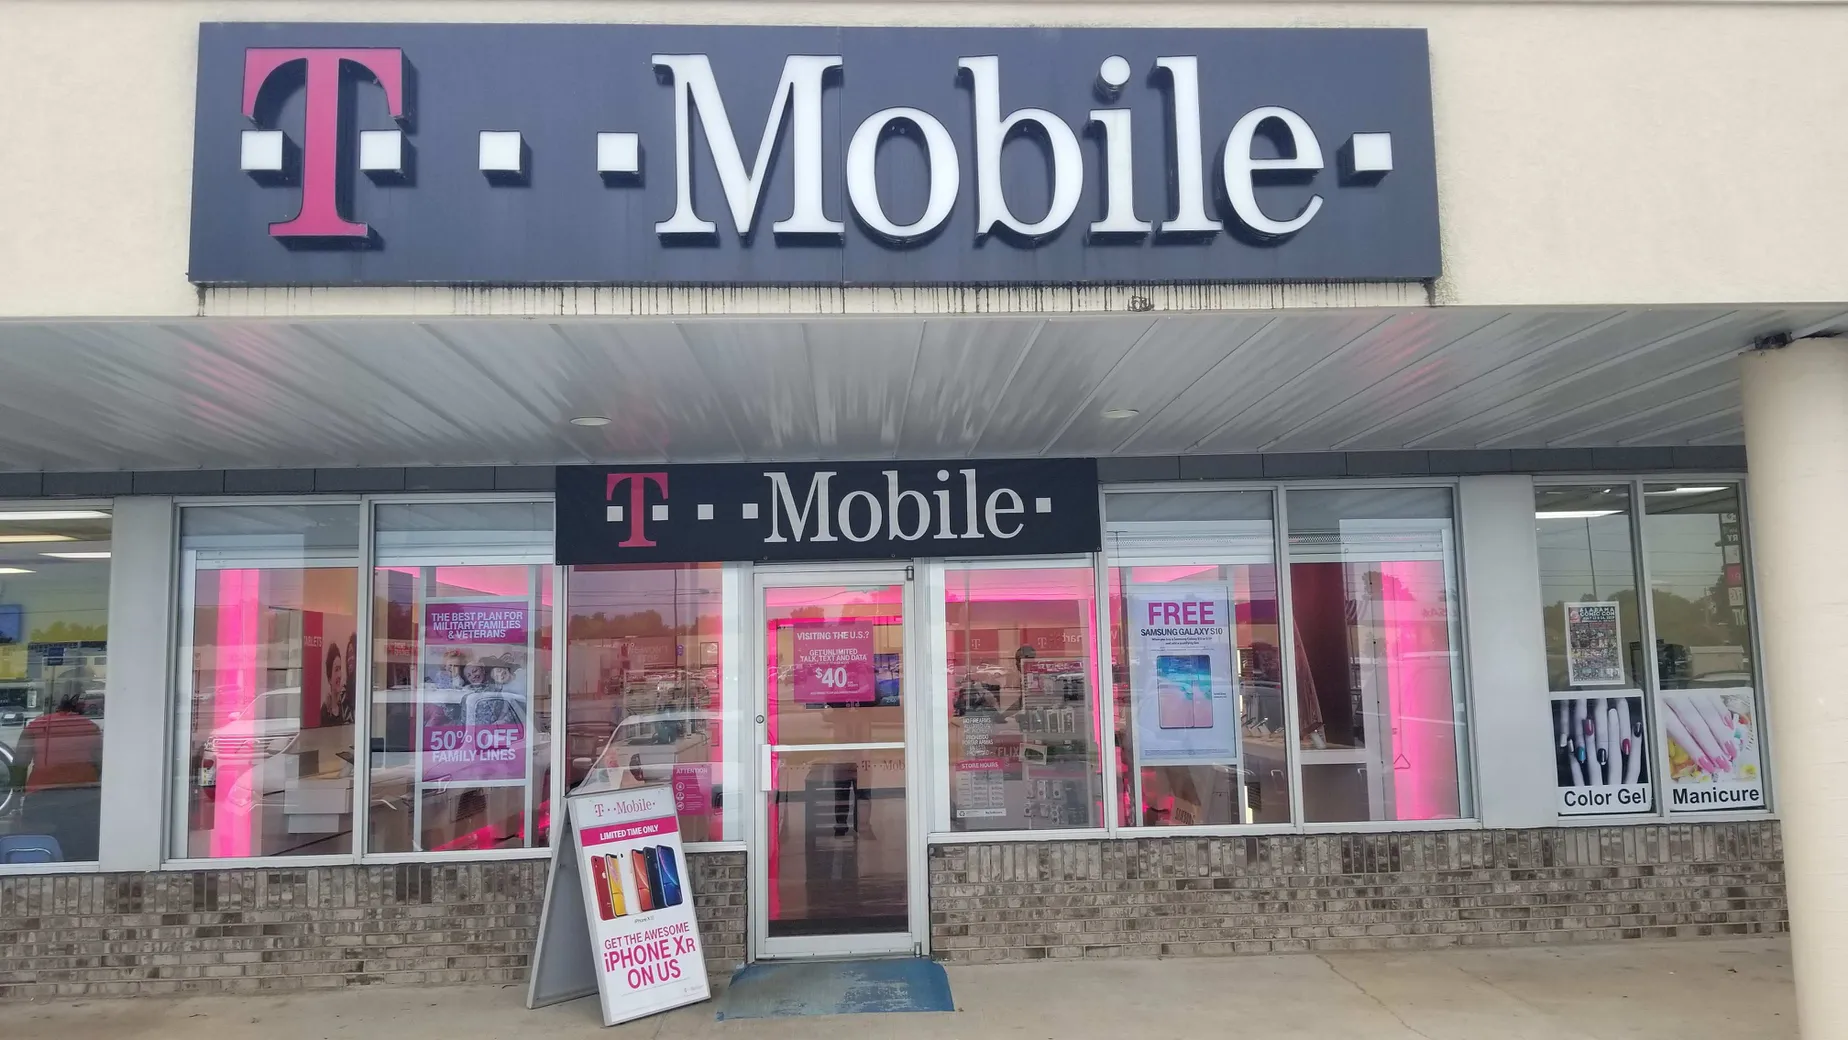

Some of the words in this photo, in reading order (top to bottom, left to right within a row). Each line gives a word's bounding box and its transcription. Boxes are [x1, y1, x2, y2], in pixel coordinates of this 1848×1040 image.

[651, 54, 1324, 237] Mobile
[763, 469, 1024, 543] Mobile
[431, 612, 450, 622] THE
[452, 612, 476, 621] BEST
[477, 612, 502, 621] PLAN
[504, 611, 523, 620] FOR
[1148, 602, 1215, 625] FREE
[433, 621, 477, 630] MILITARY
[478, 620, 521, 629] FAMILIES
[1140, 628, 1178, 636] SAMSUNG
[448, 630, 455, 639] &
[456, 629, 506, 639] VETERANS
[797, 632, 831, 640] VISITING
[832, 631, 849, 639] THE
[850, 631, 870, 639] U.S.?
[823, 648, 858, 656] UNLIMITED
[815, 667, 847, 688] $40
[430, 730, 473, 750] 50%
[476, 728, 519, 749] OFF
[432, 749, 477, 762] FAMILY
[480, 749, 516, 761] LINES
[883, 760, 905, 771] Mob
[1564, 789, 1612, 807] Color
[1617, 788, 1647, 804] Gel
[1672, 787, 1760, 805] Manicure
[616, 799, 652, 815] Mobile
[600, 829, 627, 841] LIMITED
[627, 826, 643, 837] TIME
[642, 824, 659, 834] ONLY
[604, 936, 622, 950] GET
[623, 932, 643, 946] THE
[644, 921, 690, 942] AWESOME
[604, 938, 672, 973] iPHONE
[672, 935, 696, 957] XR
[627, 964, 655, 989] ON
[656, 958, 682, 982] US
